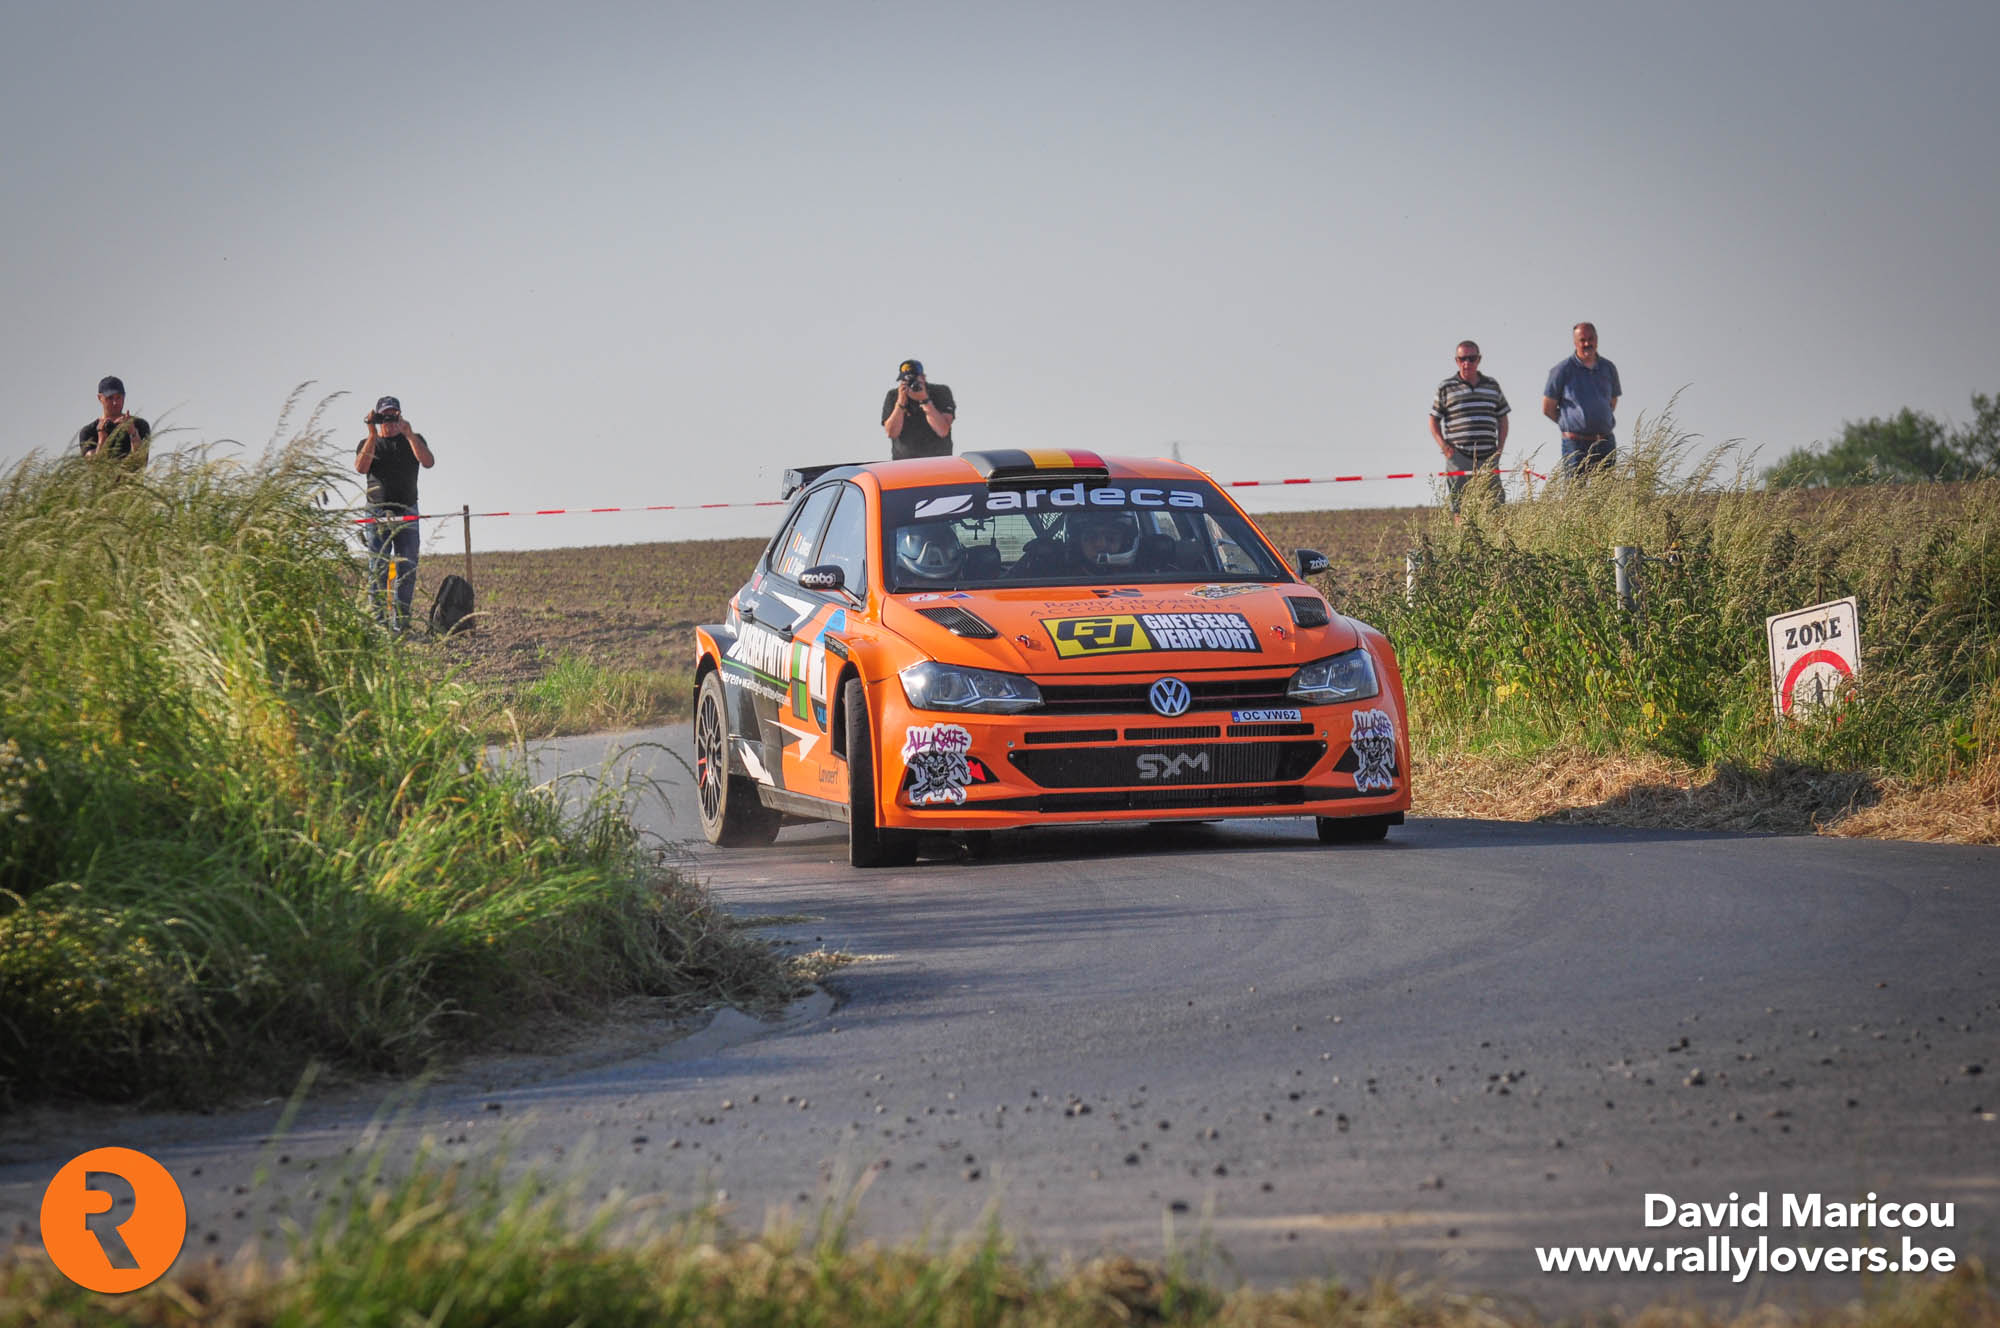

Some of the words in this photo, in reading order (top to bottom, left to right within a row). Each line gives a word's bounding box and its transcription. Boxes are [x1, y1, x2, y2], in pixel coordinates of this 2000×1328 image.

[986, 482, 1204, 510] ardeca
[1029, 603, 1241, 616] ACCOUNTANTS
[1149, 628, 1257, 650] VERPOORT
[1785, 616, 1841, 650] ZONE
[1150, 677, 1191, 717] VW
[1242, 711, 1261, 721] OC
[1266, 710, 1297, 720] VW62
[1136, 752, 1209, 779] SXM
